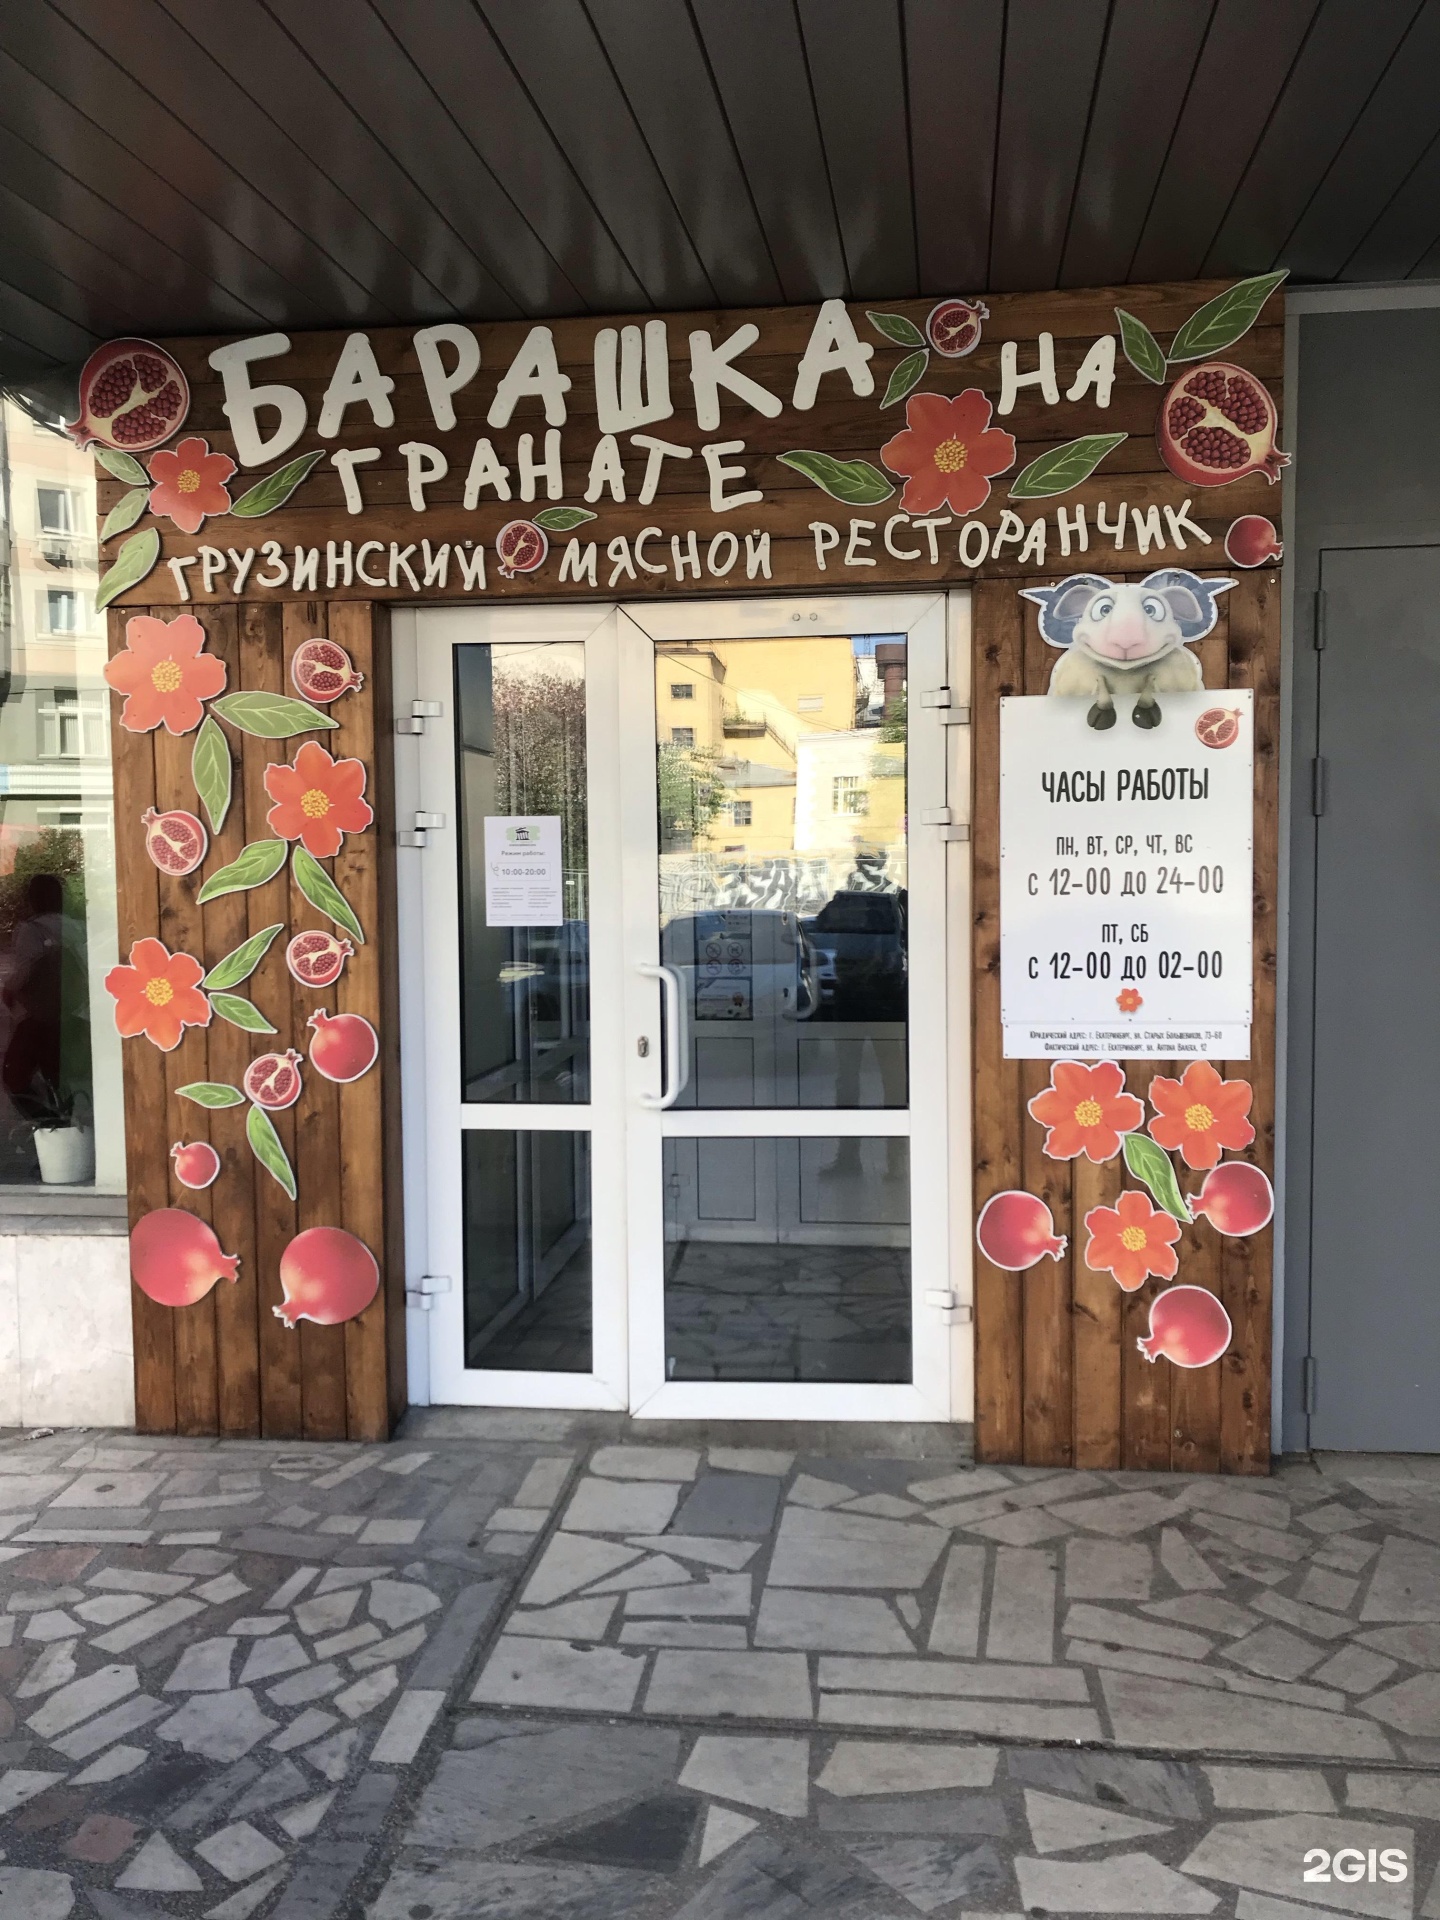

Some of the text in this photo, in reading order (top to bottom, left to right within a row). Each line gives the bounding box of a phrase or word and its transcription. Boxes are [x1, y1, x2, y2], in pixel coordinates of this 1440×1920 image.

[208, 299, 1116, 467] БАРАШКА НА
[331, 428, 763, 514] ГРАНАТЕ
[167, 499, 1212, 600] ГРУЗИНСКИЙ МЯСНОЙ РЕСТОРАНЧИК
[1042, 767, 1209, 803] ЧАСЫ РАБОТЫ
[1056, 834, 1193, 857] ПН, ВТ, СР, ЧТ, ВС
[501, 868, 546, 876] 10:00-20:00
[1048, 867, 1111, 896] 12-00
[1156, 865, 1224, 894] 24-00
[1101, 923, 1149, 945] ПТ, СБ
[1048, 951, 1111, 980] 12-00
[1158, 950, 1222, 979] 02-00
